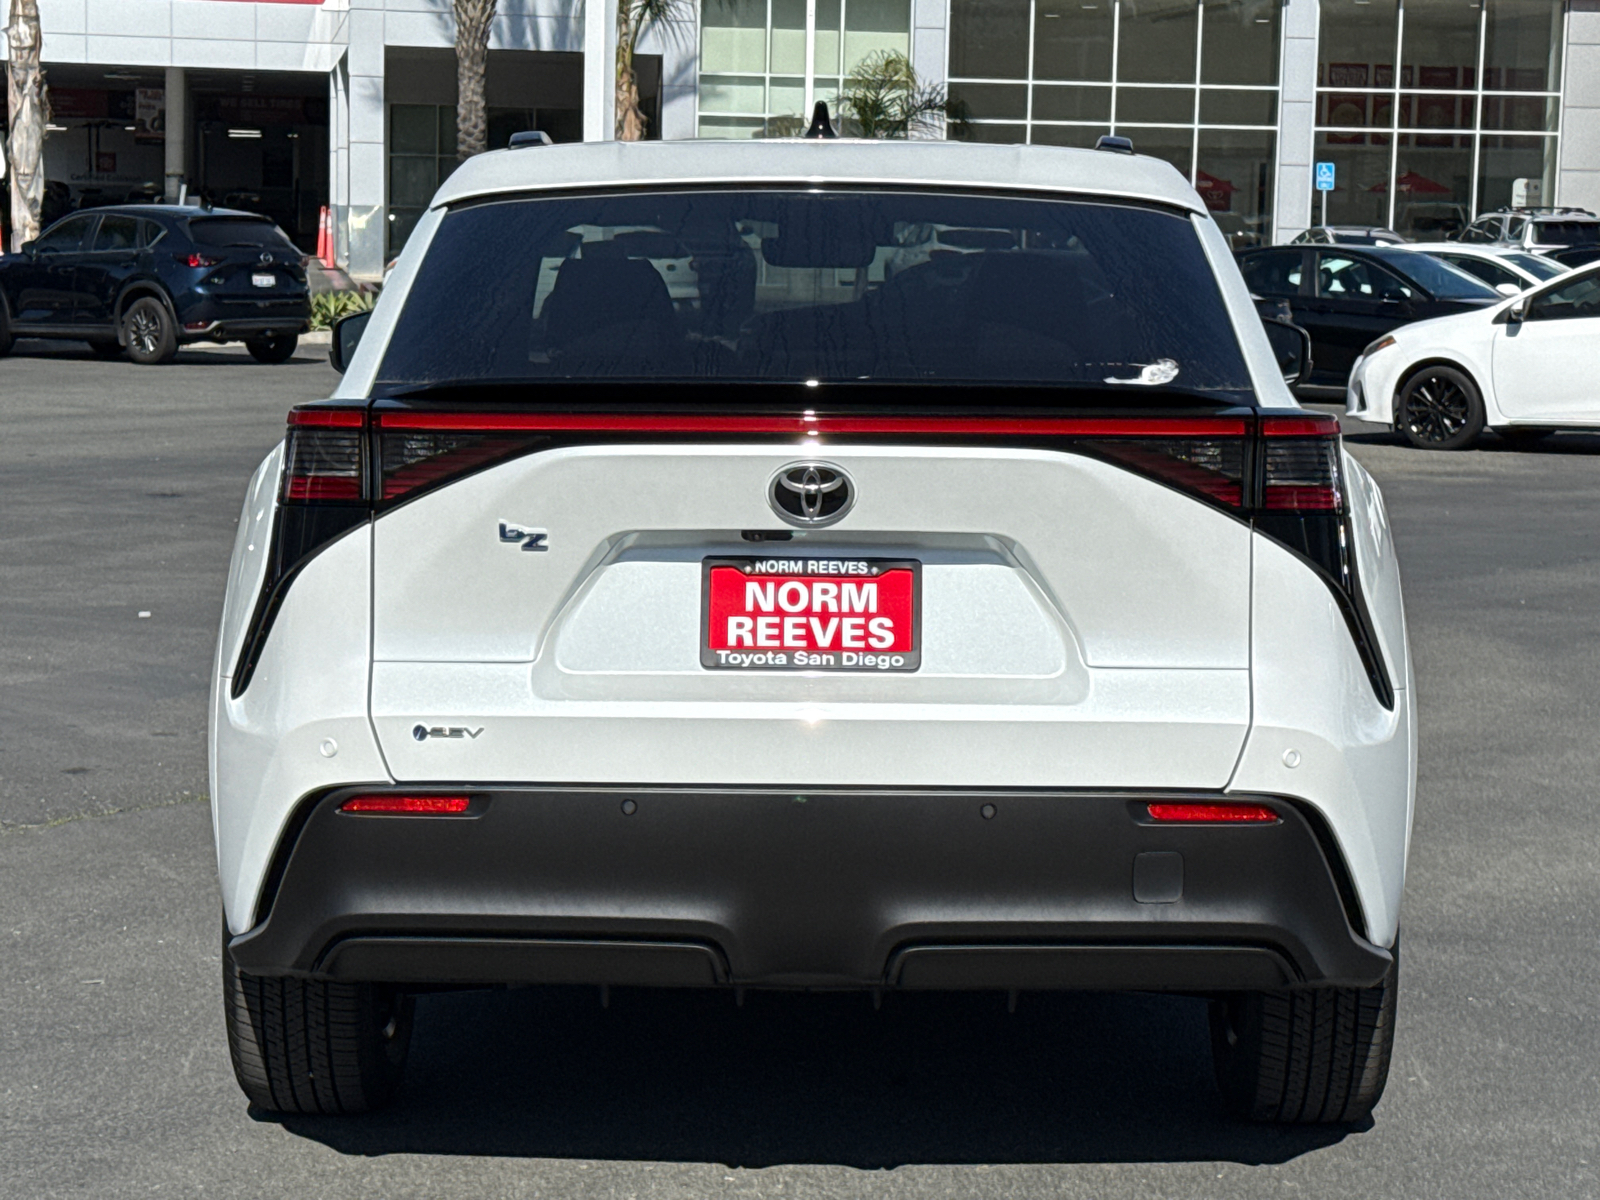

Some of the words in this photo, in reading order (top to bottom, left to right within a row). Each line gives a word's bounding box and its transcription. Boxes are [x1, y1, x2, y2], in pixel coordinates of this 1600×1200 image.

[755, 560, 803, 573] NORM
[807, 561, 868, 574] REEVES
[745, 581, 878, 613] NORM
[727, 616, 895, 649] REEVES
[716, 650, 787, 667] Toyota
[793, 651, 835, 666] San
[842, 652, 904, 669] Diego
